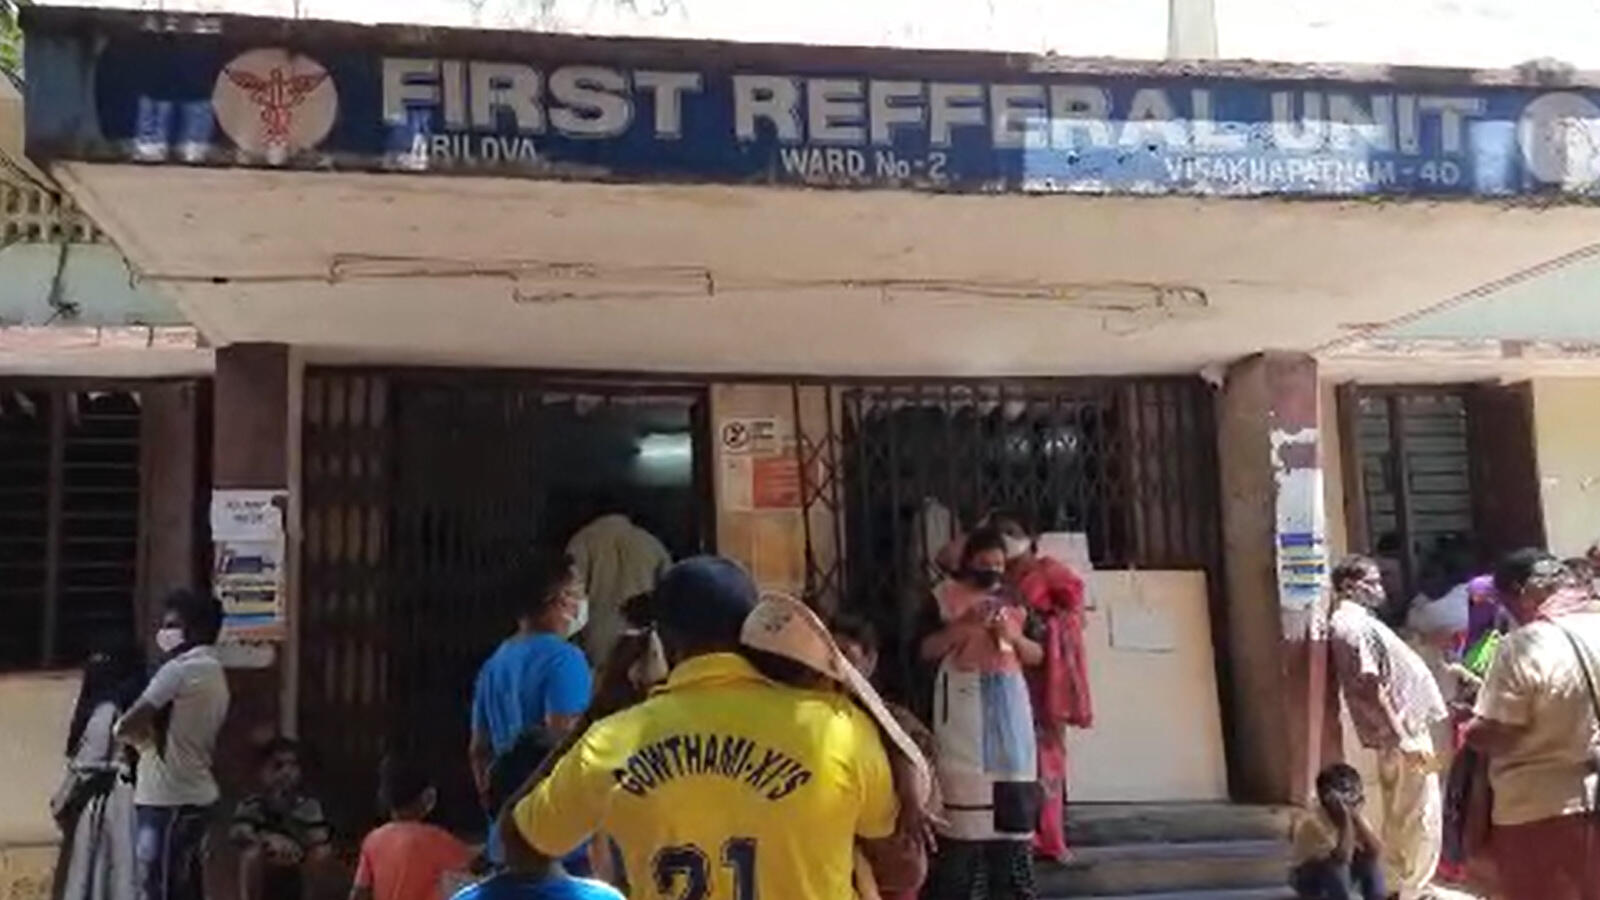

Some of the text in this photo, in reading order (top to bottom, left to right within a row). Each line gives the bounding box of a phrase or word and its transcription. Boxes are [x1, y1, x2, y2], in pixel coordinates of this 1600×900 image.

[382, 56, 1486, 154] FIRST REFFERAL UNIT
[780, 148, 865, 179] WARD
